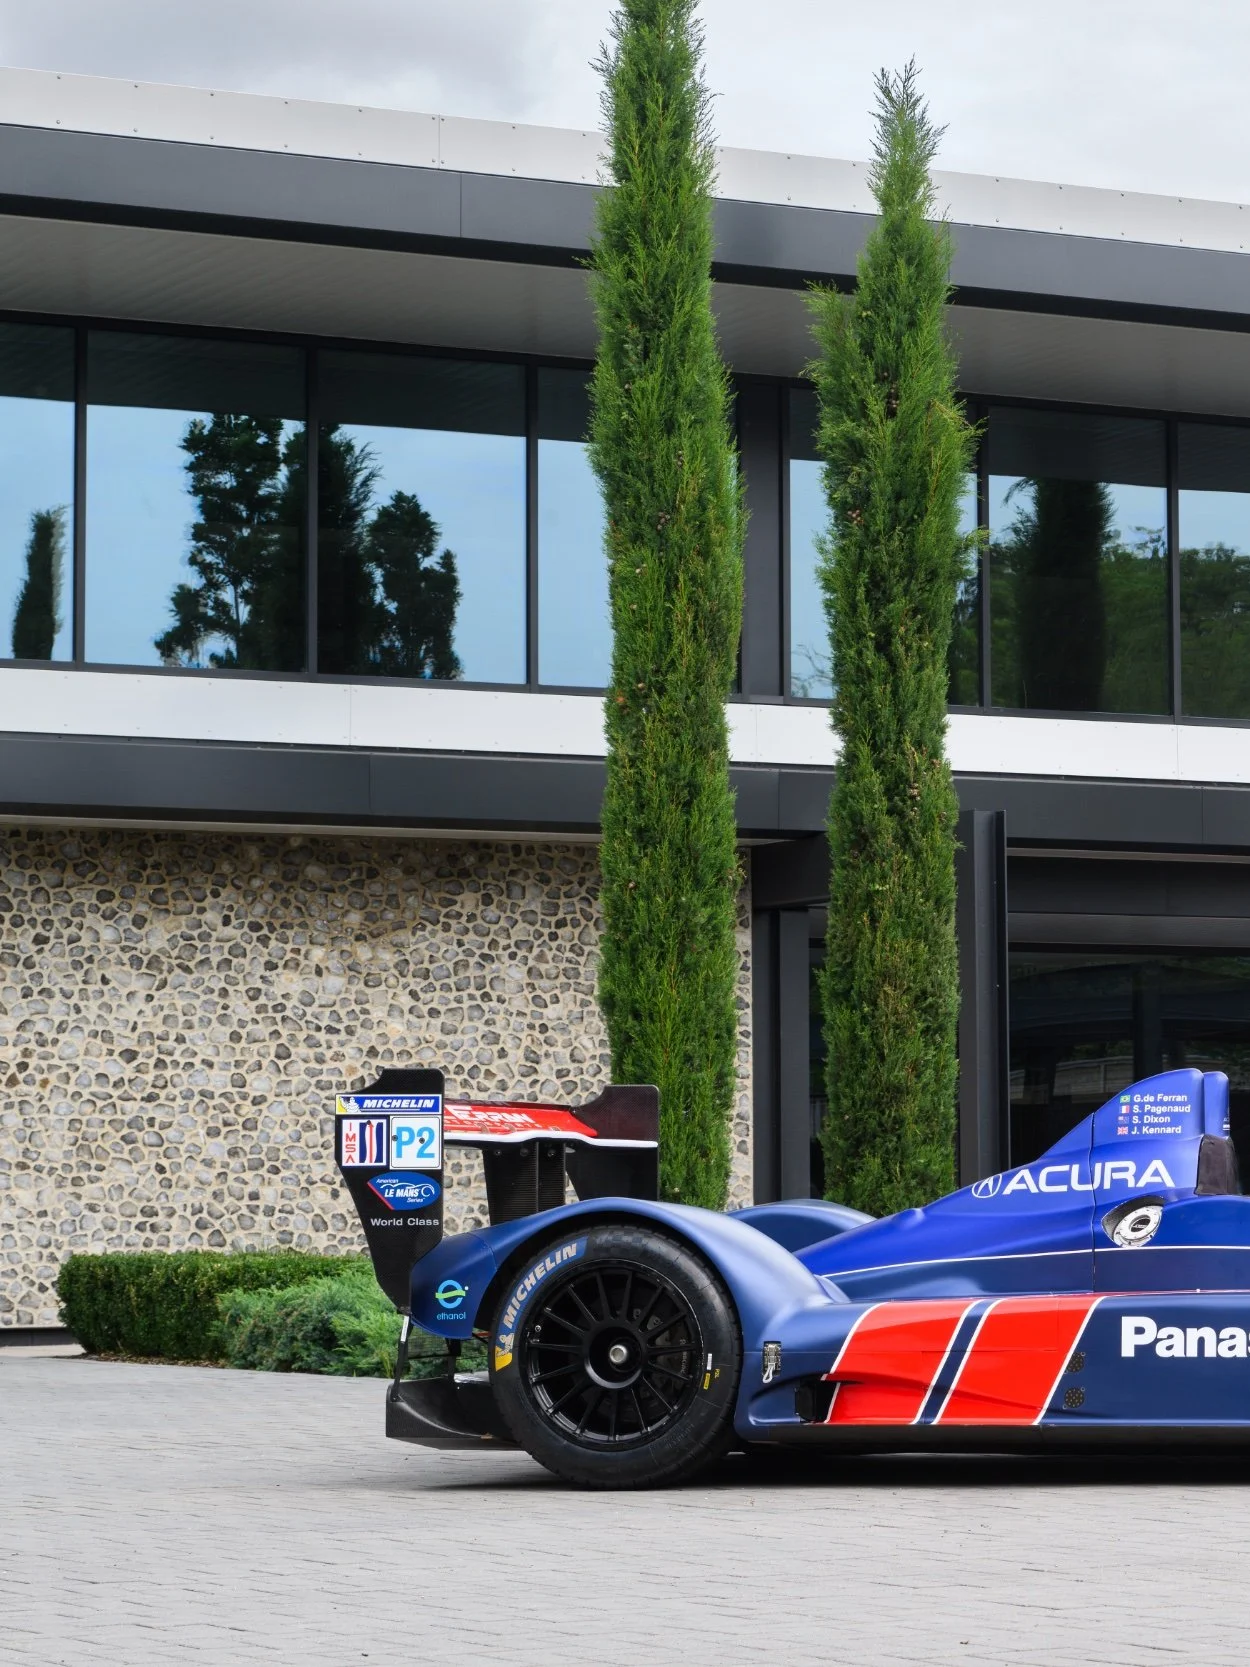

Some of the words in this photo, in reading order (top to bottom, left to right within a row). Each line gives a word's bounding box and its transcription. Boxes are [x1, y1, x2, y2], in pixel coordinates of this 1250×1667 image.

[1157, 1094, 1188, 1102] Ferran
[363, 1099, 435, 1108] MICHELIN
[1132, 1104, 1142, 1113] S.
[1144, 1104, 1191, 1114] Pagenaud
[1132, 1115, 1141, 1123] S.
[1143, 1115, 1171, 1123] Dixon
[1131, 1126, 1140, 1134] J.
[1142, 1126, 1182, 1134] Kennard
[345, 1122, 356, 1164] IMSA
[395, 1126, 436, 1158] P2
[1002, 1160, 1176, 1195] ACURA
[384, 1188, 395, 1198] LE
[396, 1188, 419, 1198] MANS
[371, 1217, 404, 1226] World
[407, 1217, 440, 1226] Class
[503, 1243, 577, 1330] MICHELIN
[436, 1312, 467, 1321] ethanol
